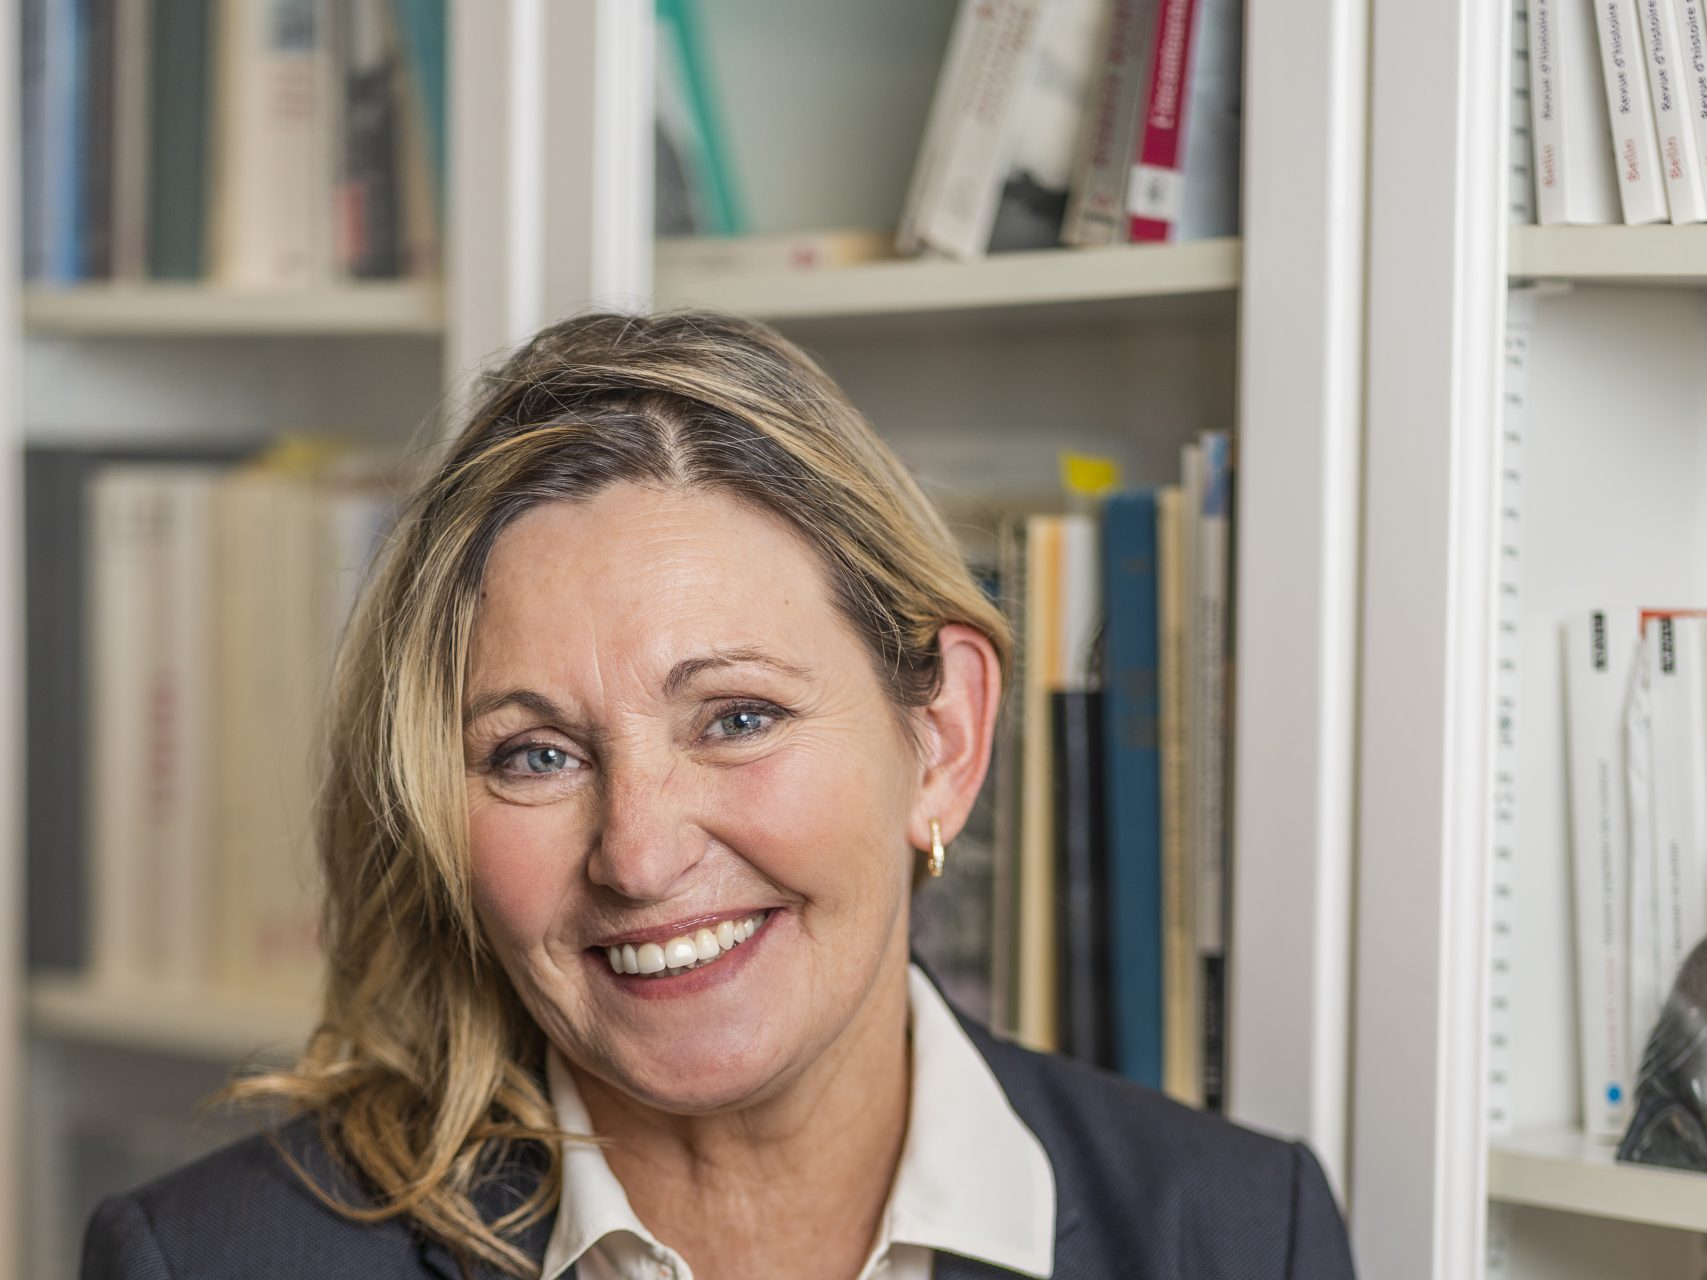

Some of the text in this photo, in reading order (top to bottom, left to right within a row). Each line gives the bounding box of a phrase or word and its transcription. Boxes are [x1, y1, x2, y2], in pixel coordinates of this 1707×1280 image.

[1608, 3, 1631, 114] Revue d'histoire
[1687, 8, 1705, 73] d'histoire
[1659, 70, 1672, 111] Revue
